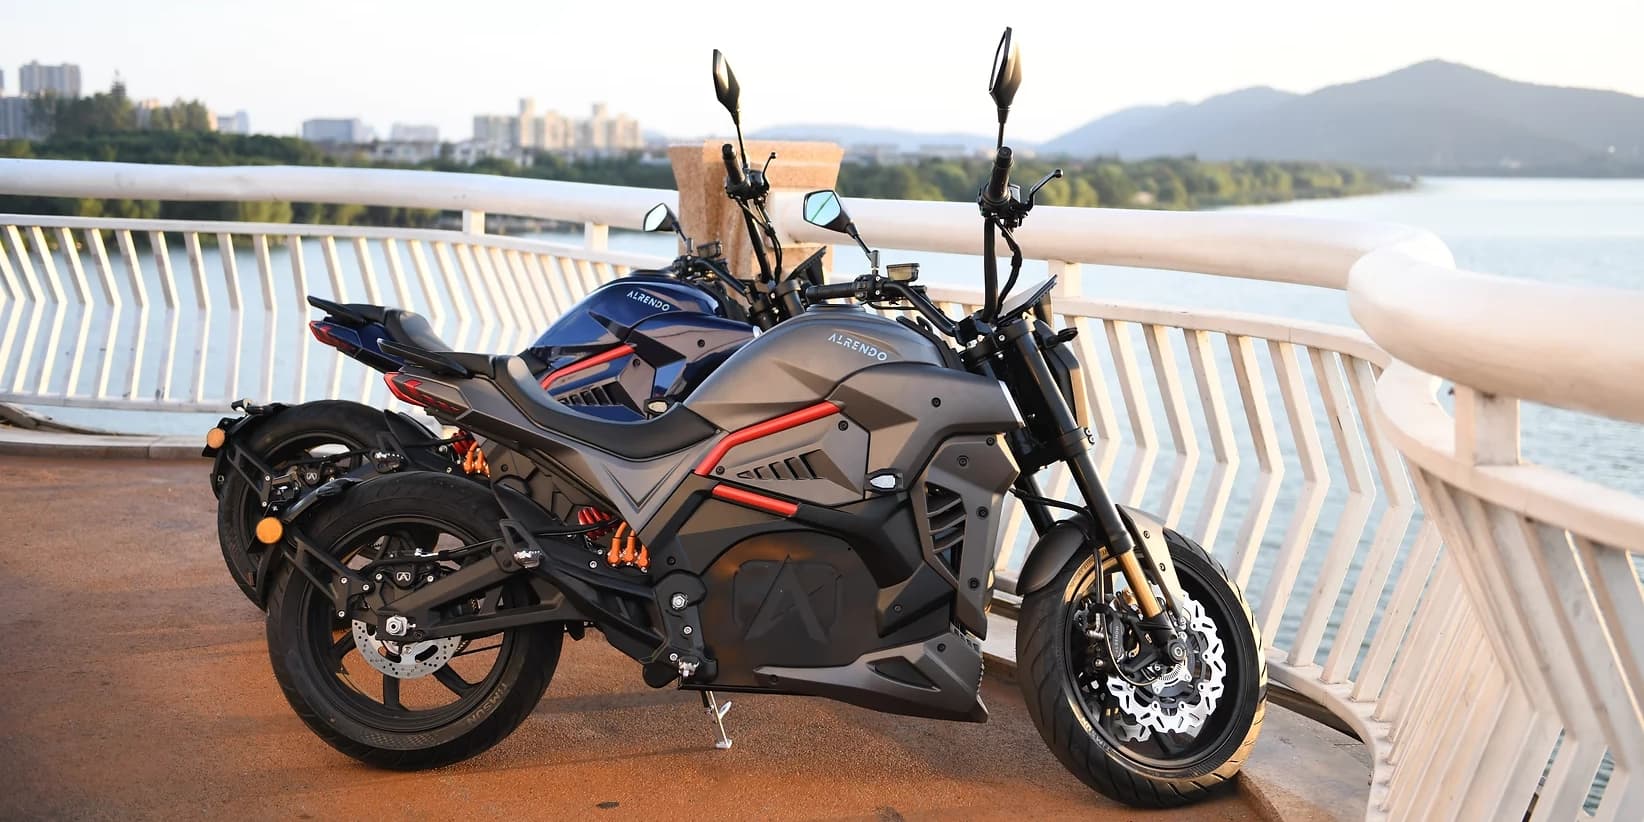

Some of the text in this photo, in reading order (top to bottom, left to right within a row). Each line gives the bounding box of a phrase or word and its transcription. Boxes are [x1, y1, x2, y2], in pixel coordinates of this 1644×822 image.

[627, 290, 670, 311] ALRENDO
[828, 332, 888, 361] ALRENDO
[467, 682, 508, 724] TIMSUN
